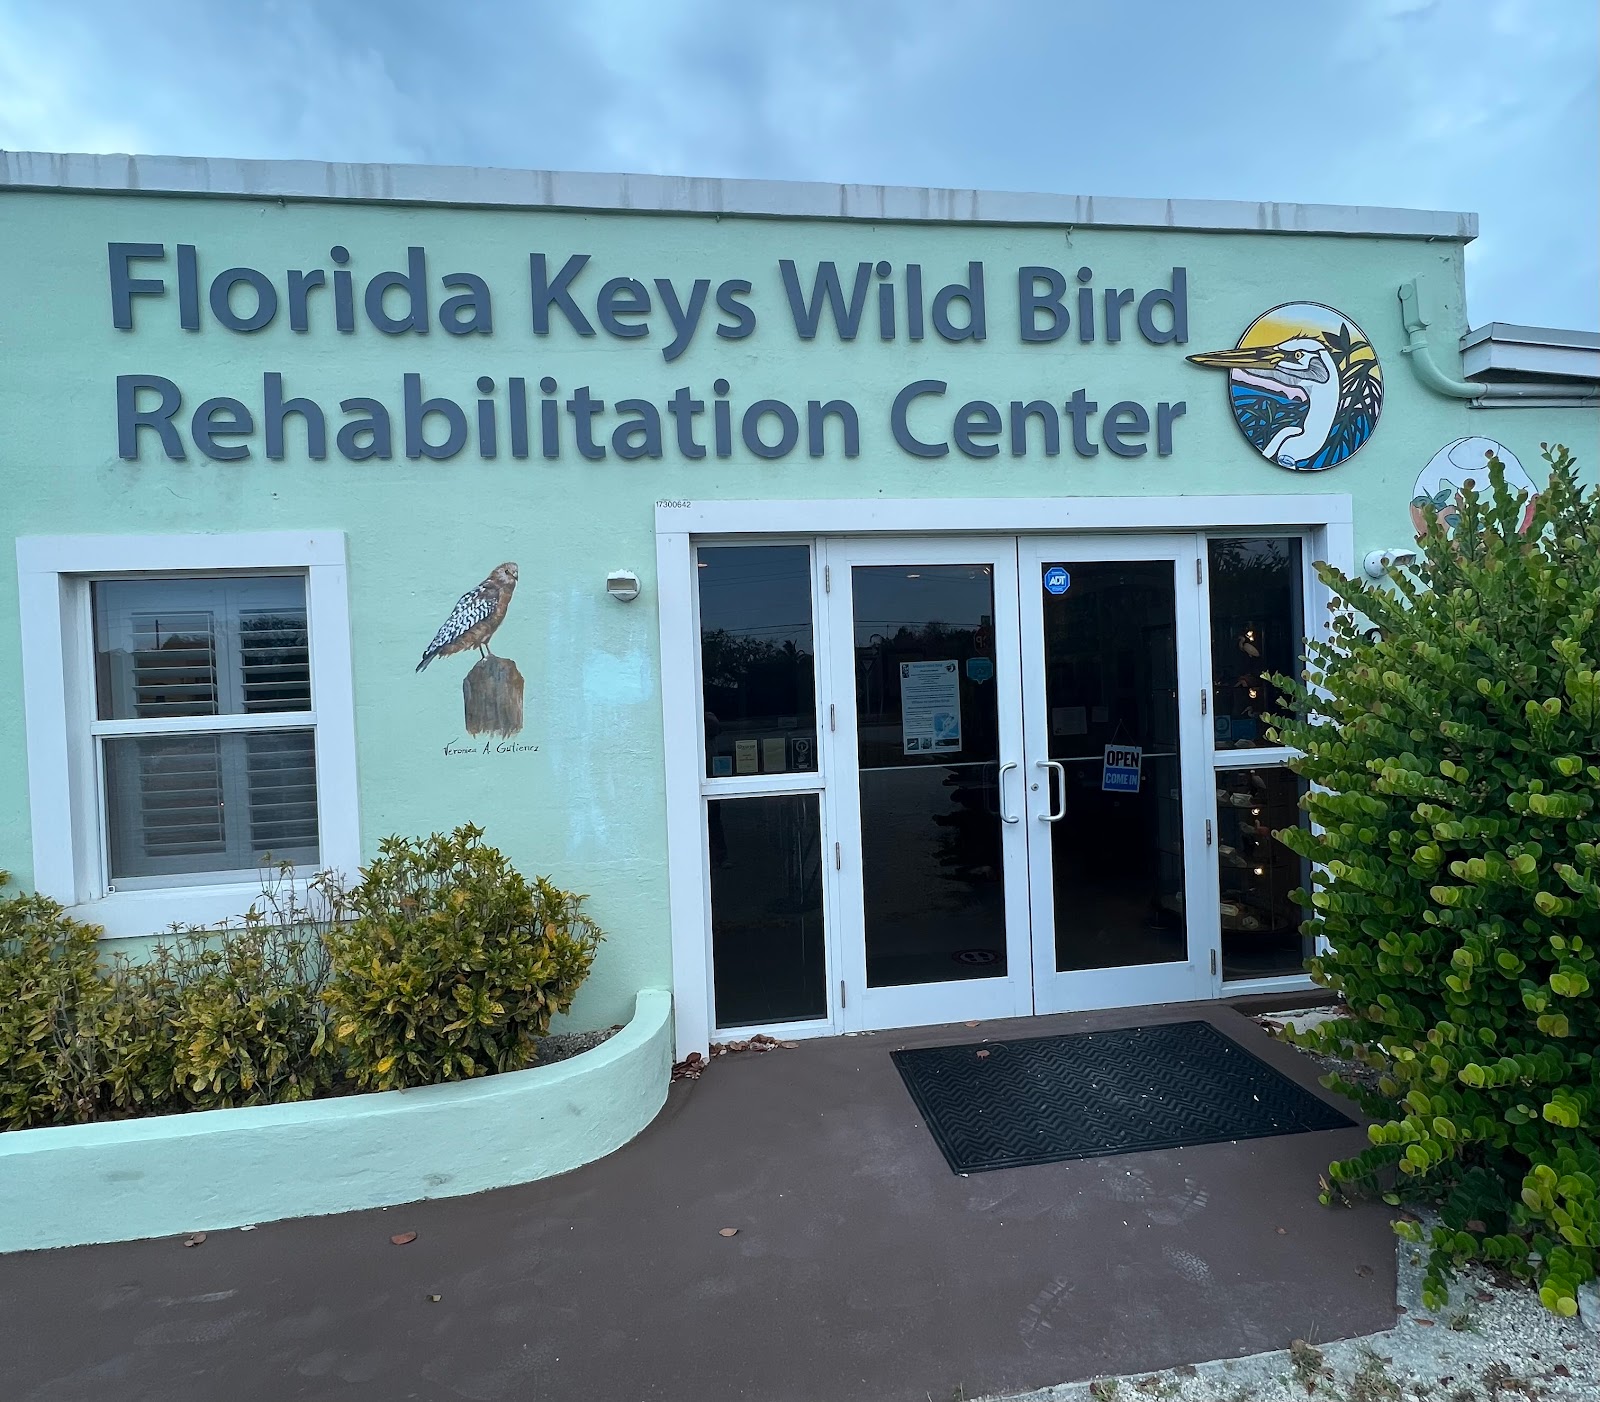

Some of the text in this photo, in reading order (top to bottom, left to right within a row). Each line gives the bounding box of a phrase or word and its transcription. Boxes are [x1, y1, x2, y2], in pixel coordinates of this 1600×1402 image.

[108, 241, 1189, 364] Florida Keys Wild Bird
[116, 371, 1187, 464] Rehabilitation Center
[655, 500, 692, 509] 17300642
[1048, 575, 1067, 586] ADT
[1106, 750, 1140, 768] OPEN
[1106, 772, 1138, 786] COME IN
